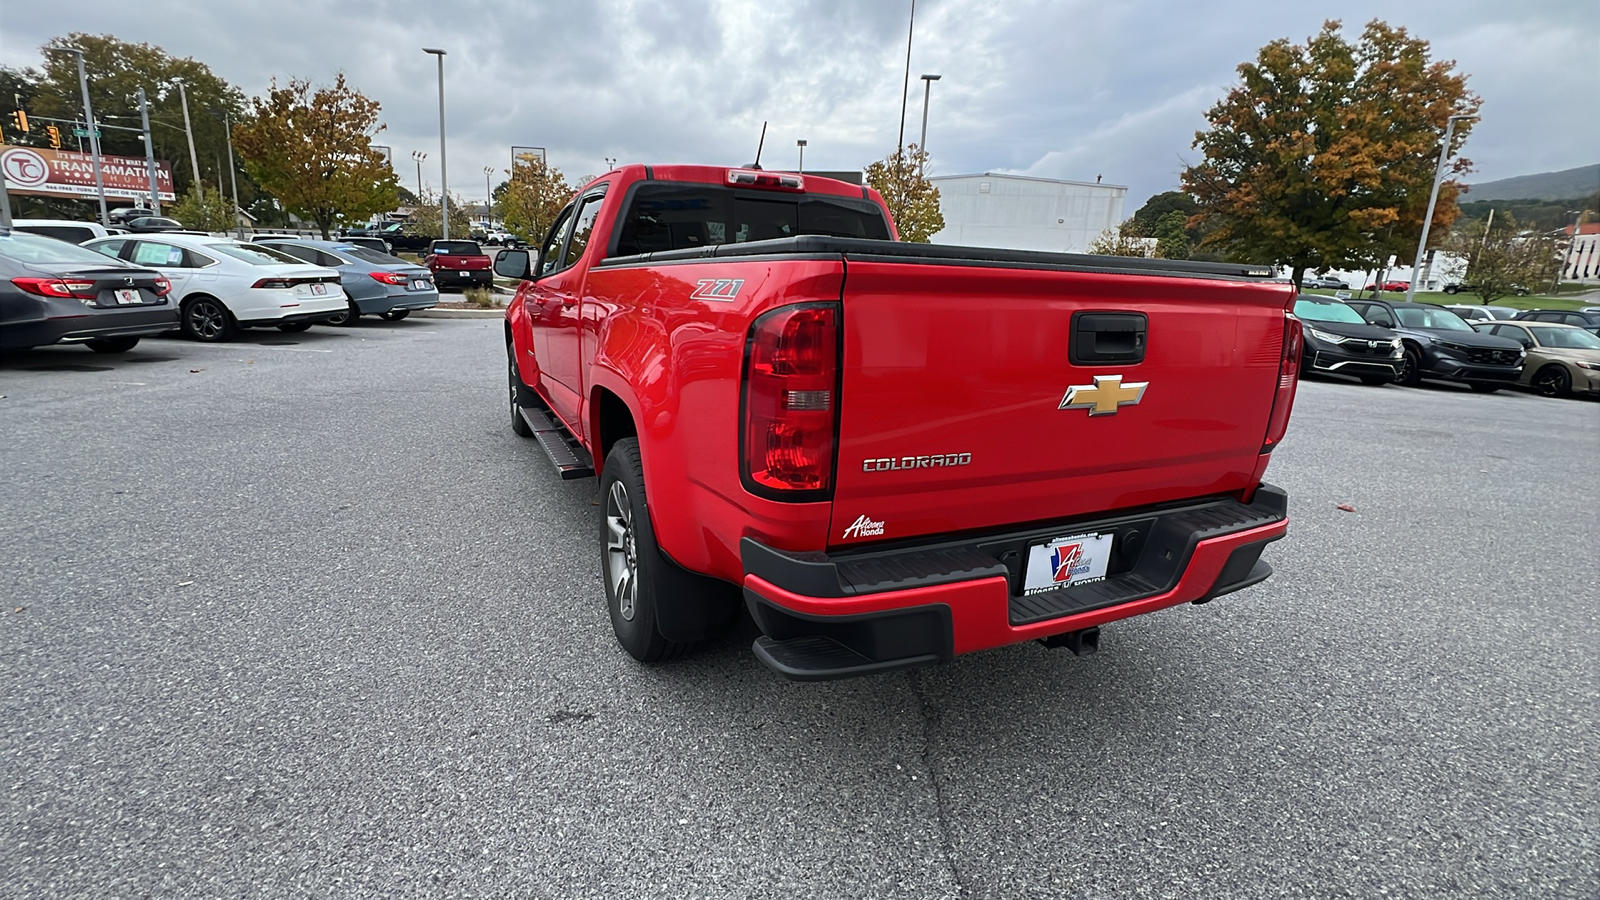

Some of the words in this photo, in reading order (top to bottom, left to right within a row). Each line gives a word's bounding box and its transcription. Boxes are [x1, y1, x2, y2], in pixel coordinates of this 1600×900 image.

[50, 160, 169, 180] TRAN4MATION
[113, 157, 125, 165] IT'S
[689, 279, 745, 302] Z71
[862, 452, 972, 472] COLORADO
[842, 514, 885, 539] Altoona
[860, 528, 884, 537] Honda
